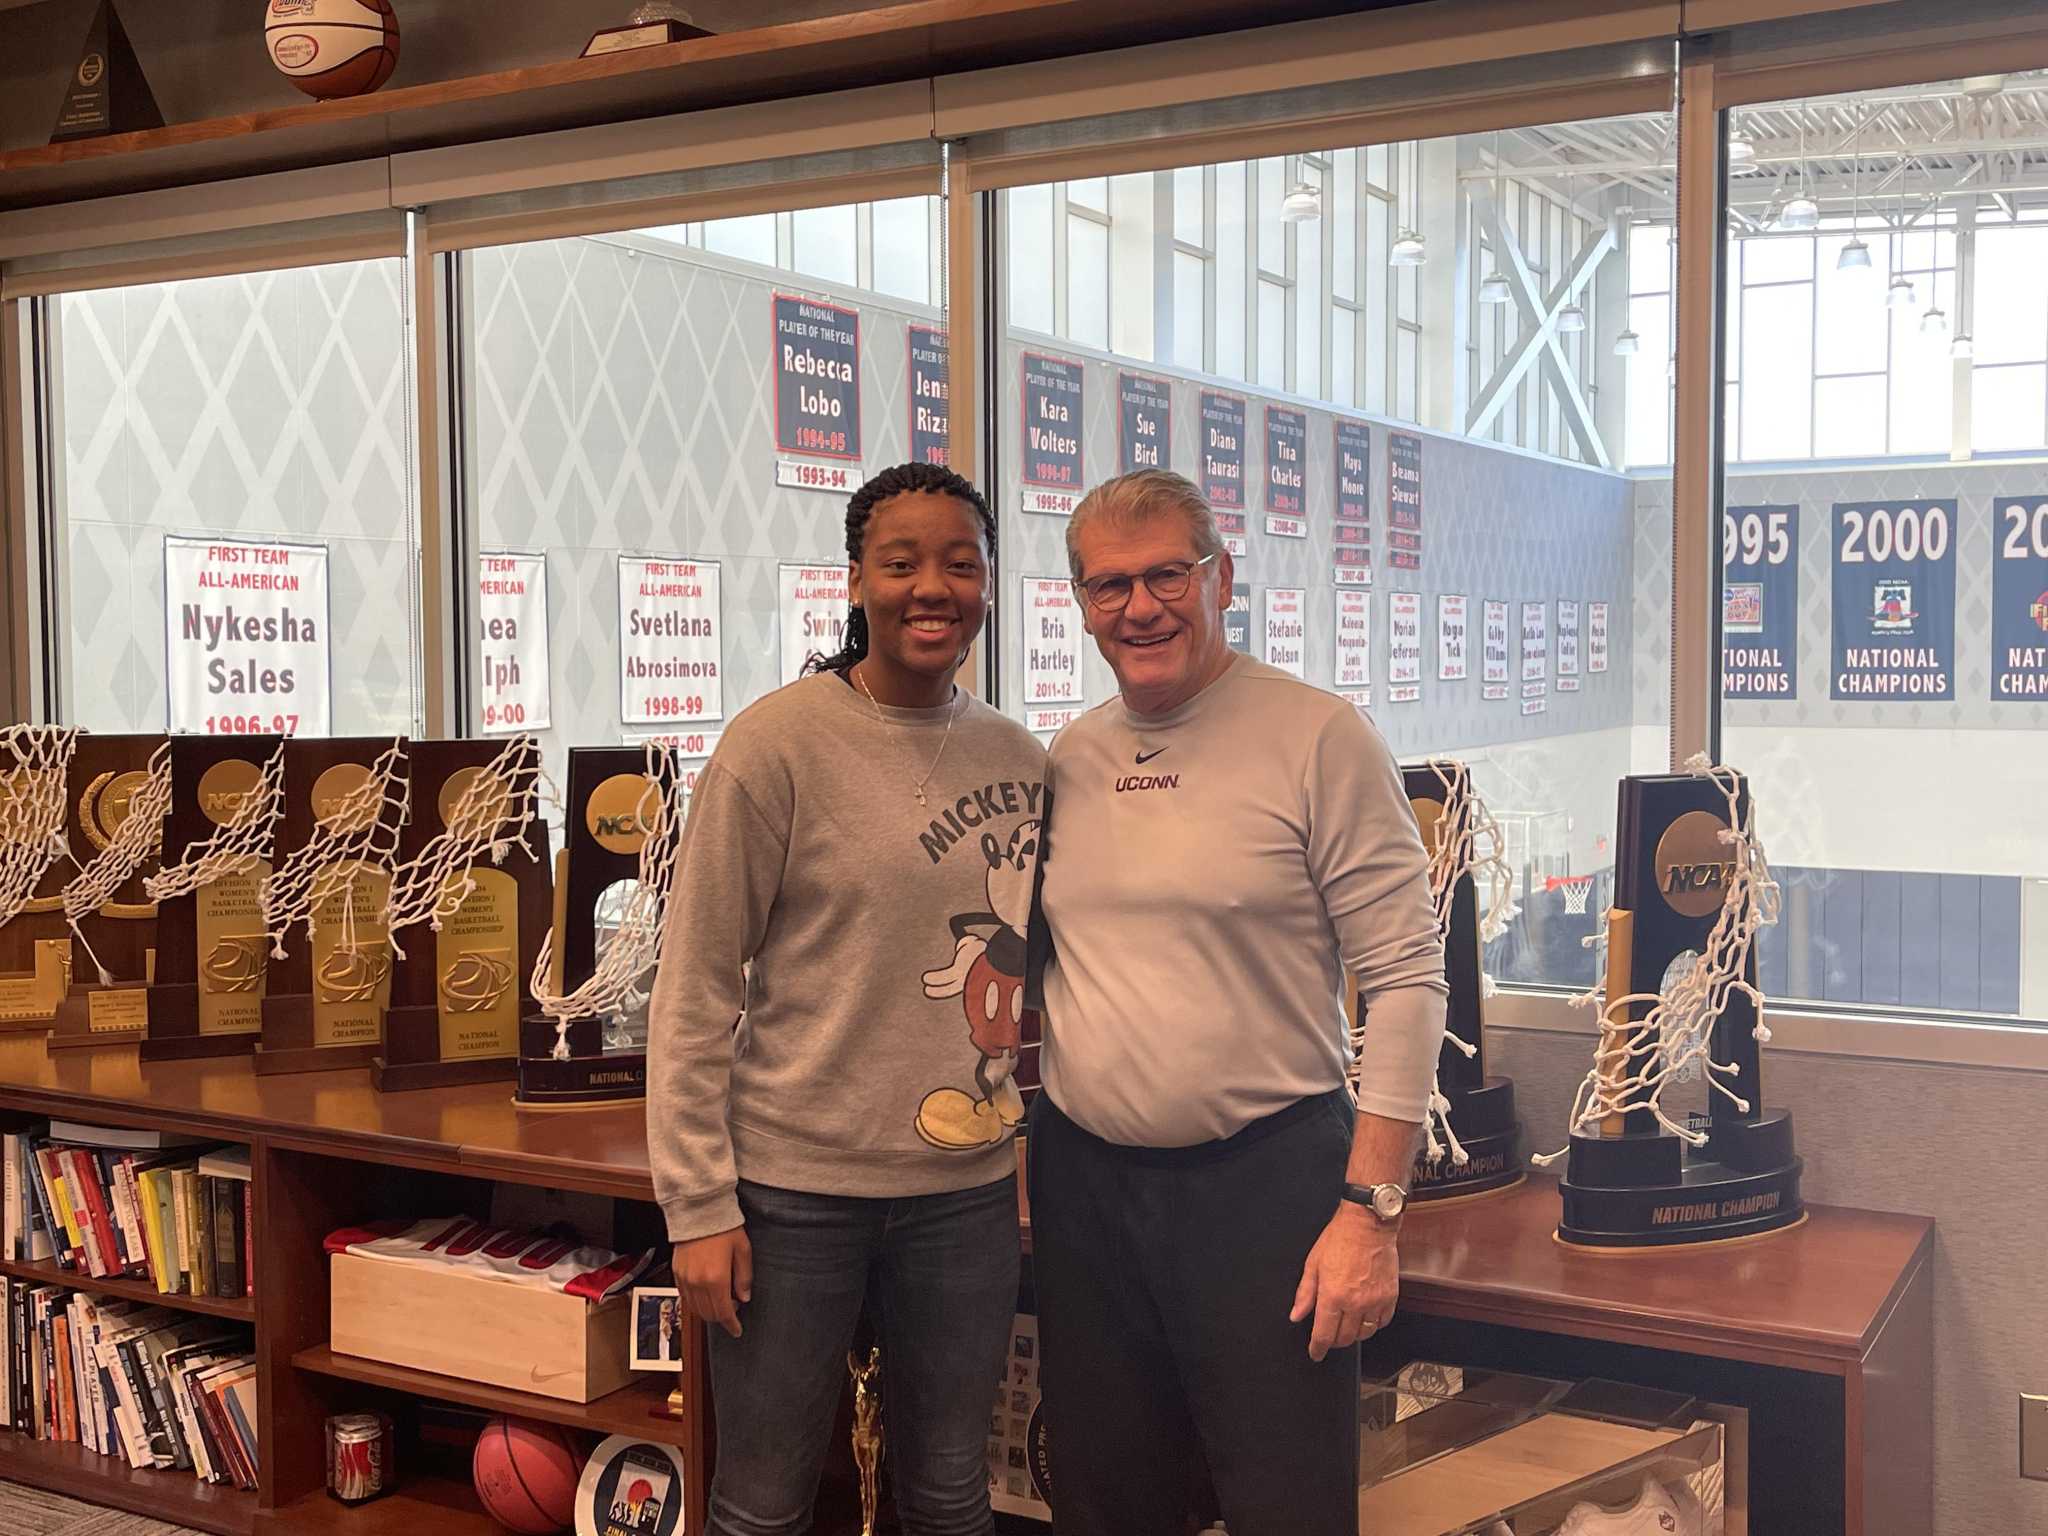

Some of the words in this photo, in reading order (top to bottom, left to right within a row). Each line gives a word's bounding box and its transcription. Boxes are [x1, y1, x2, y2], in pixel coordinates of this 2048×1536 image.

[799, 304, 835, 322] NATIONAL
[779, 320, 807, 336] PLAYER
[809, 325, 818, 338] OF
[821, 328, 834, 341] THE
[784, 344, 852, 382] Rebecca
[801, 385, 841, 417] Lobo
[1040, 396, 1068, 422] Kara
[1136, 412, 1156, 436] Sue
[1030, 427, 1077, 455] Wolters
[1210, 427, 1236, 451] Diana
[1134, 442, 1158, 466] Bird
[1277, 440, 1297, 462] Tina
[1206, 454, 1240, 479] Taurasi
[1344, 451, 1362, 476] Maya
[796, 464, 846, 488] 1993-94
[1271, 465, 1301, 488] Charles
[1342, 475, 1364, 497] Moore
[1841, 507, 1948, 563] 2000
[208, 546, 247, 563] FIRST
[253, 548, 289, 565] TEAM
[487, 559, 516, 572] TEAM
[198, 571, 299, 592] ALL-AMERICAN
[645, 563, 669, 577] FIRST
[672, 564, 697, 577] TEAM
[801, 570, 820, 580] FIRST
[824, 570, 843, 581] TEAM
[639, 583, 702, 598] ALL-AMERICAN
[795, 588, 848, 599] ALL-AMERICAN
[182, 603, 316, 651] Nykesha
[629, 609, 712, 637] Svetlana
[803, 611, 841, 637] Swin
[1042, 616, 1065, 639] Bria
[1268, 620, 1302, 638] Stefanie
[626, 656, 717, 679] Abrosimova
[1030, 648, 1075, 676] Hartley
[1846, 649, 1939, 668] NATIONAL
[207, 658, 295, 694] Sales
[1838, 674, 1947, 693] CHAMPIONS
[1036, 682, 1071, 698] 2011-12
[644, 697, 703, 716] 1998-99
[1116, 774, 1180, 792] UCONN
[919, 781, 1043, 864] MICKEY
[590, 1071, 635, 1085] NATIONAL
[1652, 1202, 1717, 1224] NATIONAL
[1722, 1191, 1780, 1217] CHAMPION
